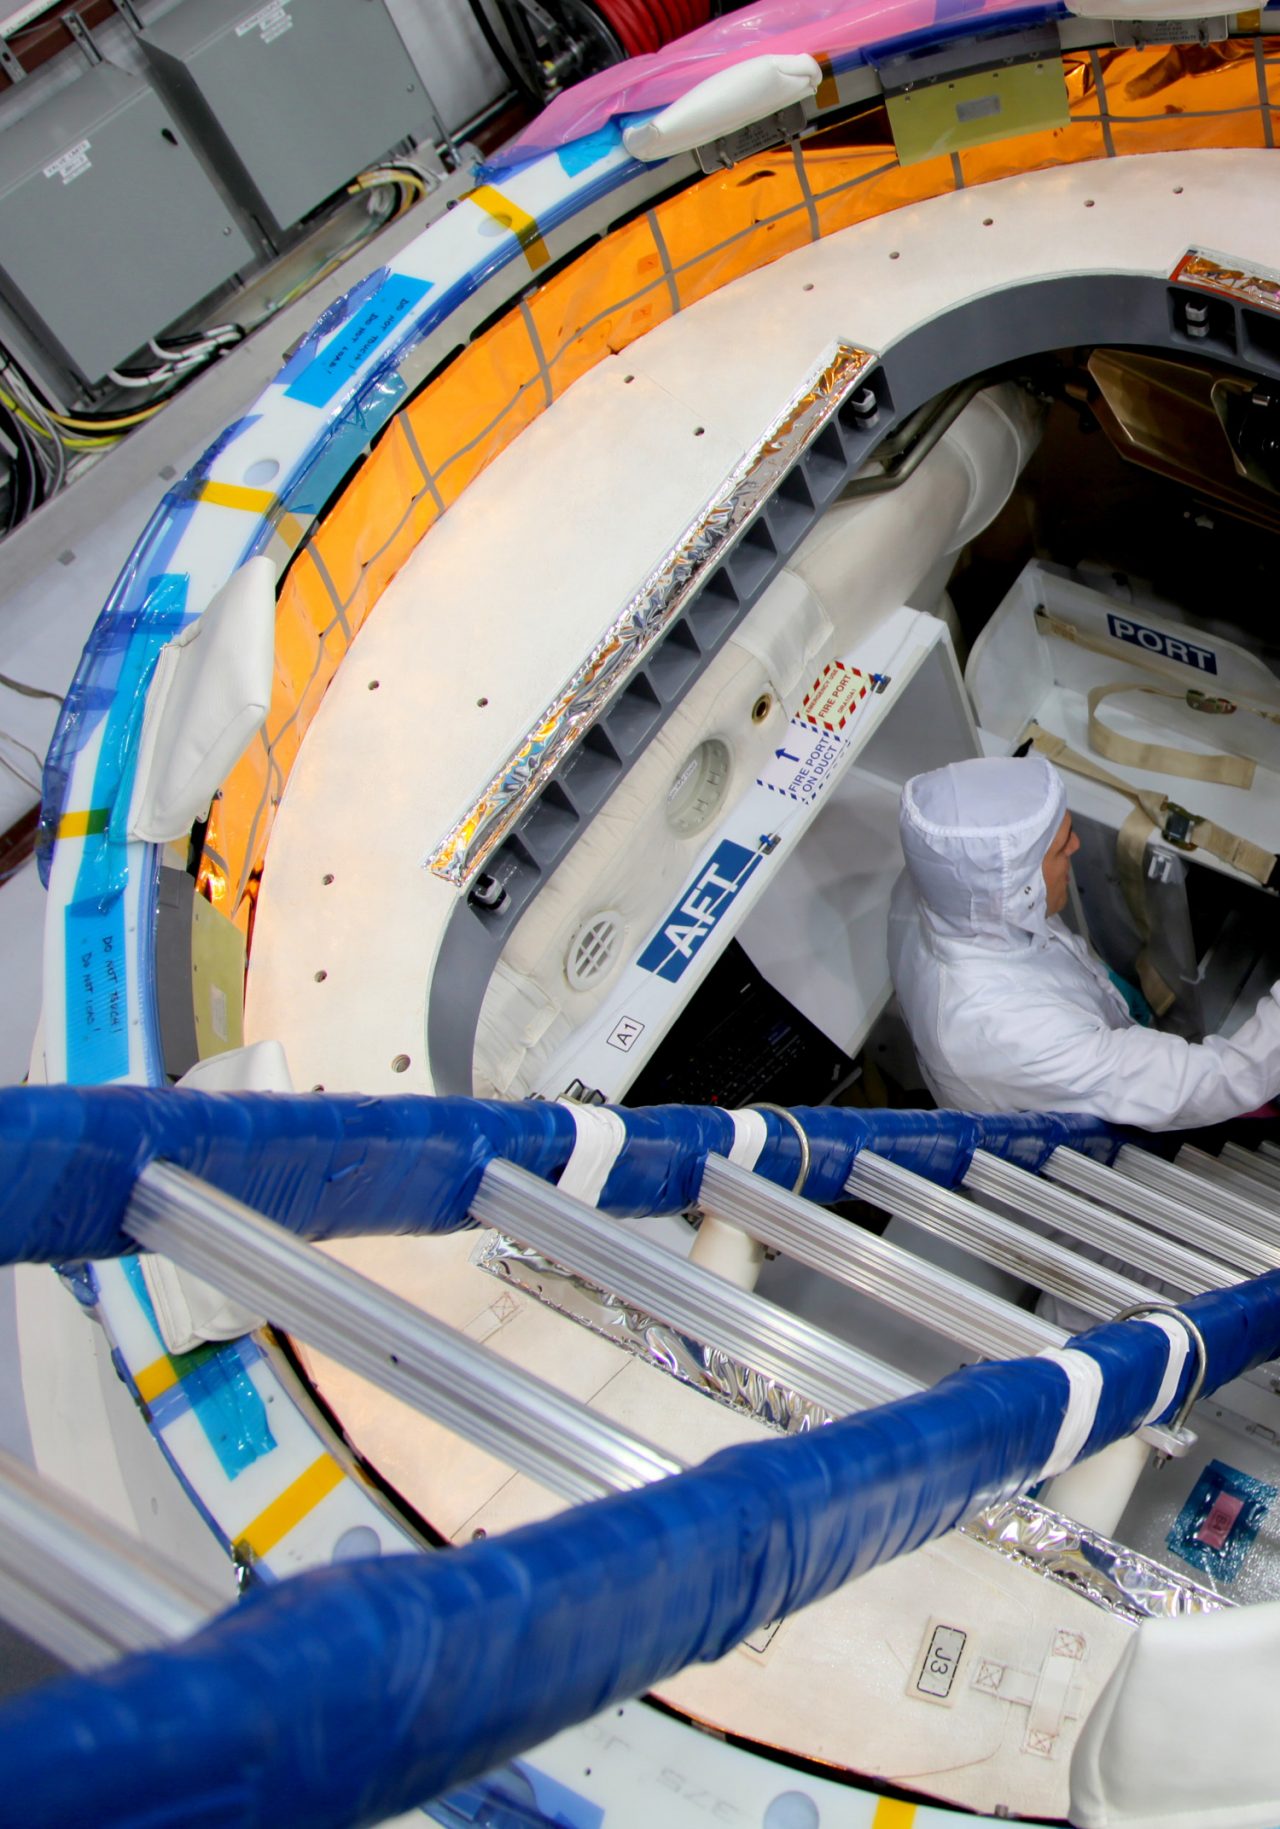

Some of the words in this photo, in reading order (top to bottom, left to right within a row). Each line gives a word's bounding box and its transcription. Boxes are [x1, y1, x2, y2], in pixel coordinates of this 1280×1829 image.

[1113, 618, 1211, 669] PORT
[818, 696, 834, 719] FIRE
[831, 674, 851, 699] PORT
[788, 767, 811, 793] FIRE
[806, 737, 830, 767] PORT
[802, 774, 819, 793] ON
[814, 746, 838, 776] DUCT
[664, 862, 738, 959] AFT
[616, 1022, 638, 1046] A1
[930, 1647, 953, 1675] J3
